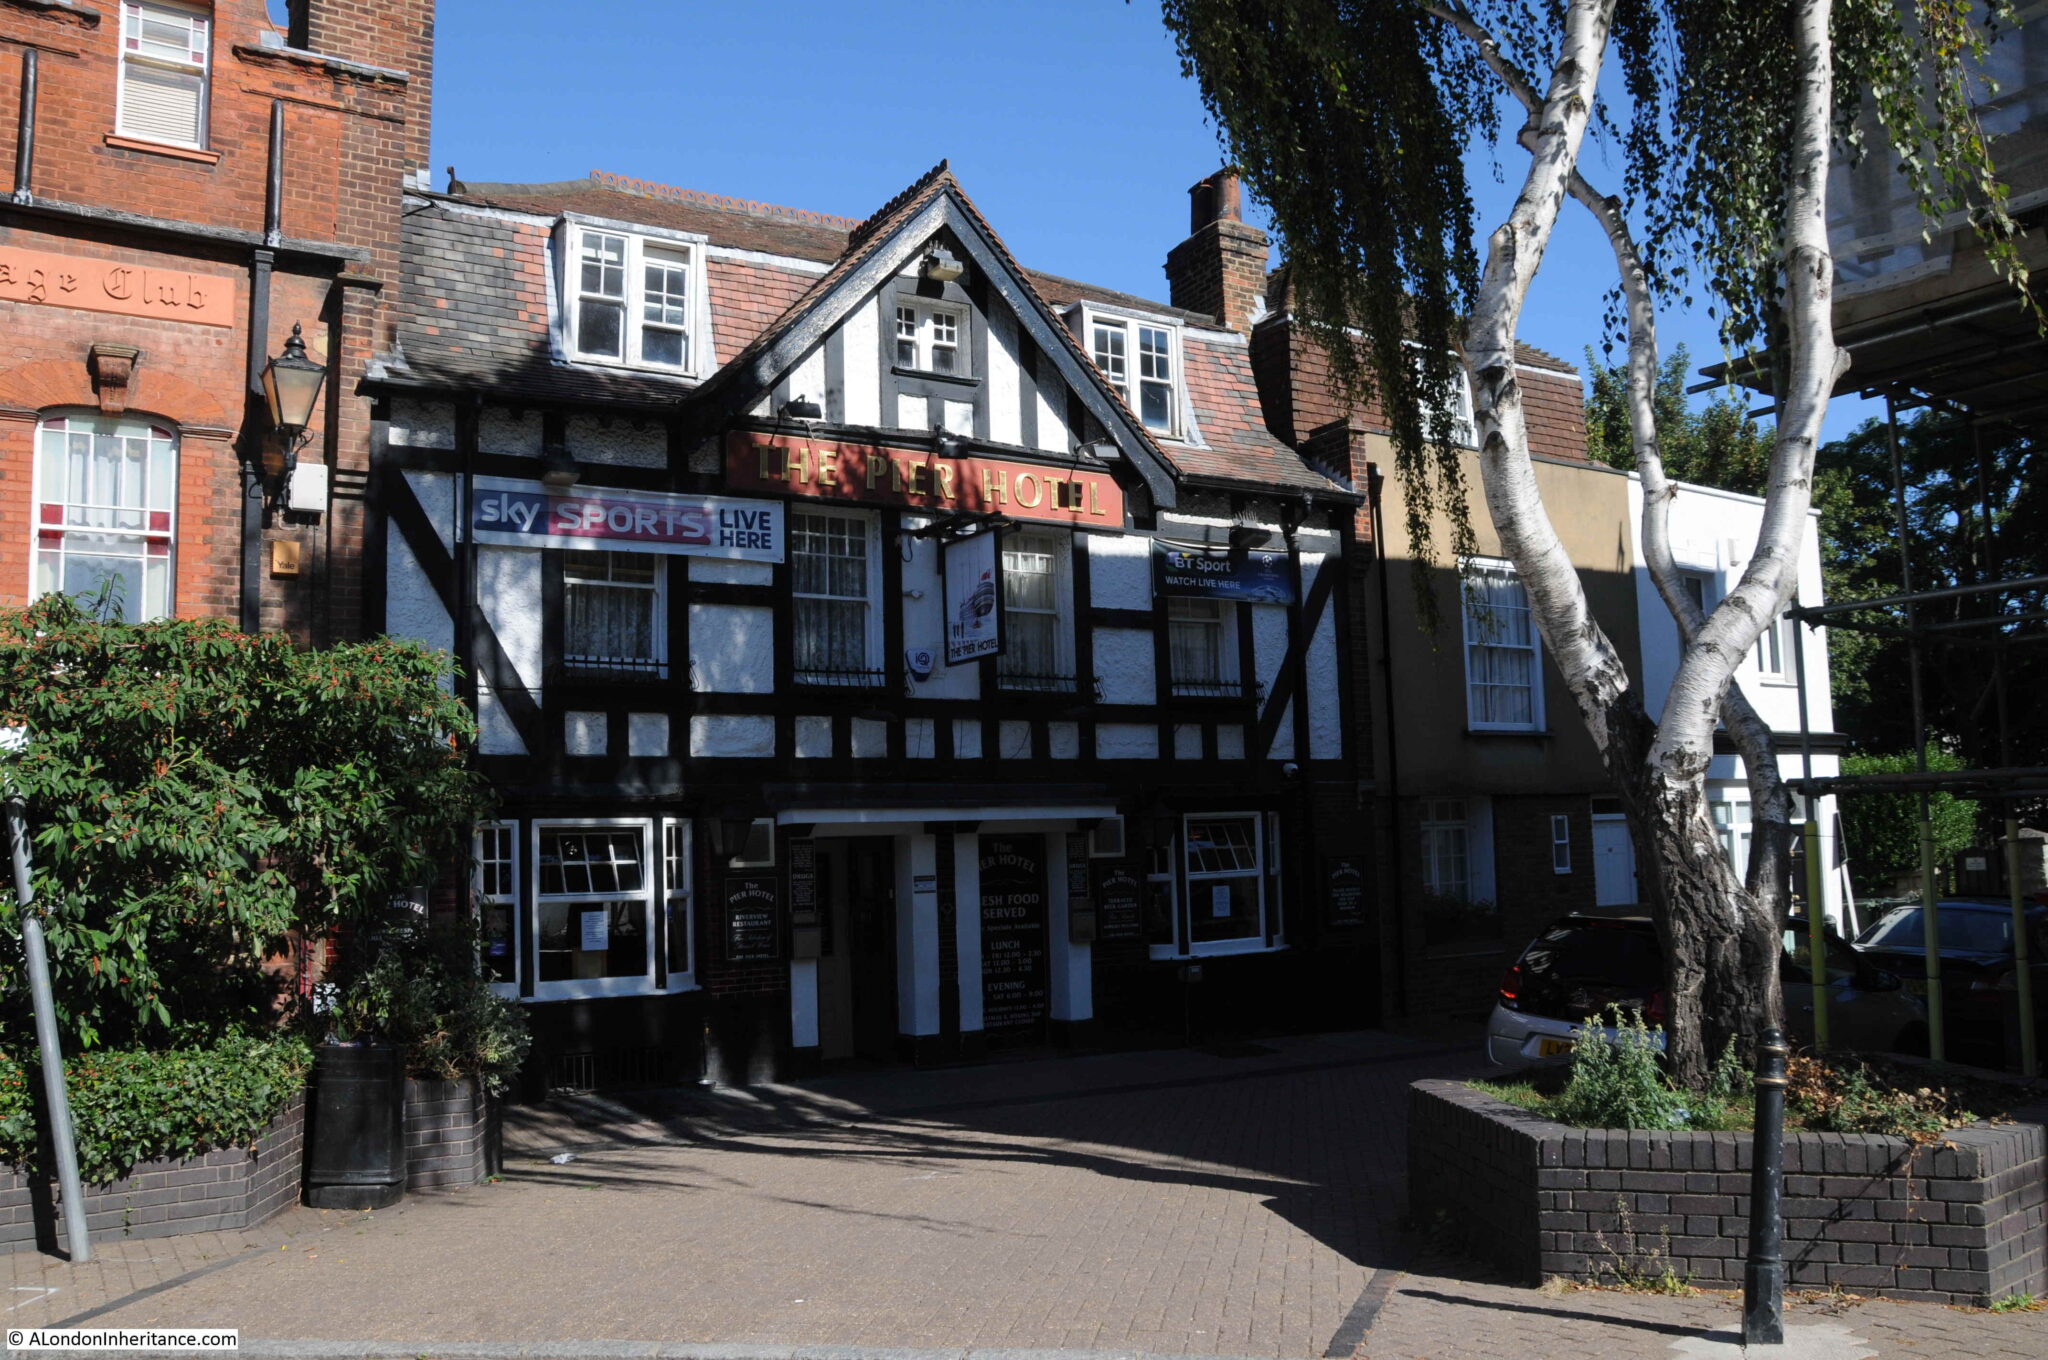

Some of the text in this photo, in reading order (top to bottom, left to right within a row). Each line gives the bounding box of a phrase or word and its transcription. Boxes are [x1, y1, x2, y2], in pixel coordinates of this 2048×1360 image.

[103, 267, 208, 309] Club
[752, 443, 1106, 516] THE PIER HOTEL
[480, 493, 706, 538] sky SPORTS
[718, 508, 771, 531] LIVE
[718, 530, 772, 550] HERE
[277, 561, 295, 570] Yale
[1174, 556, 1232, 573] BT Sport
[1165, 576, 1241, 590] WATCH LIVE HERE
[951, 648, 962, 658] THE
[962, 643, 976, 655] PIER
[992, 842, 1014, 853] The
[998, 854, 1036, 874] HOTEL
[729, 890, 775, 904] PIER HOTEL
[1007, 892, 1040, 905] FOOD
[393, 900, 424, 915] HOTEL
[983, 907, 1027, 919] SERVED
[732, 920, 771, 928] RESTAURANT
[990, 939, 1021, 950] LUNCH
[987, 980, 1026, 992] EVENING
